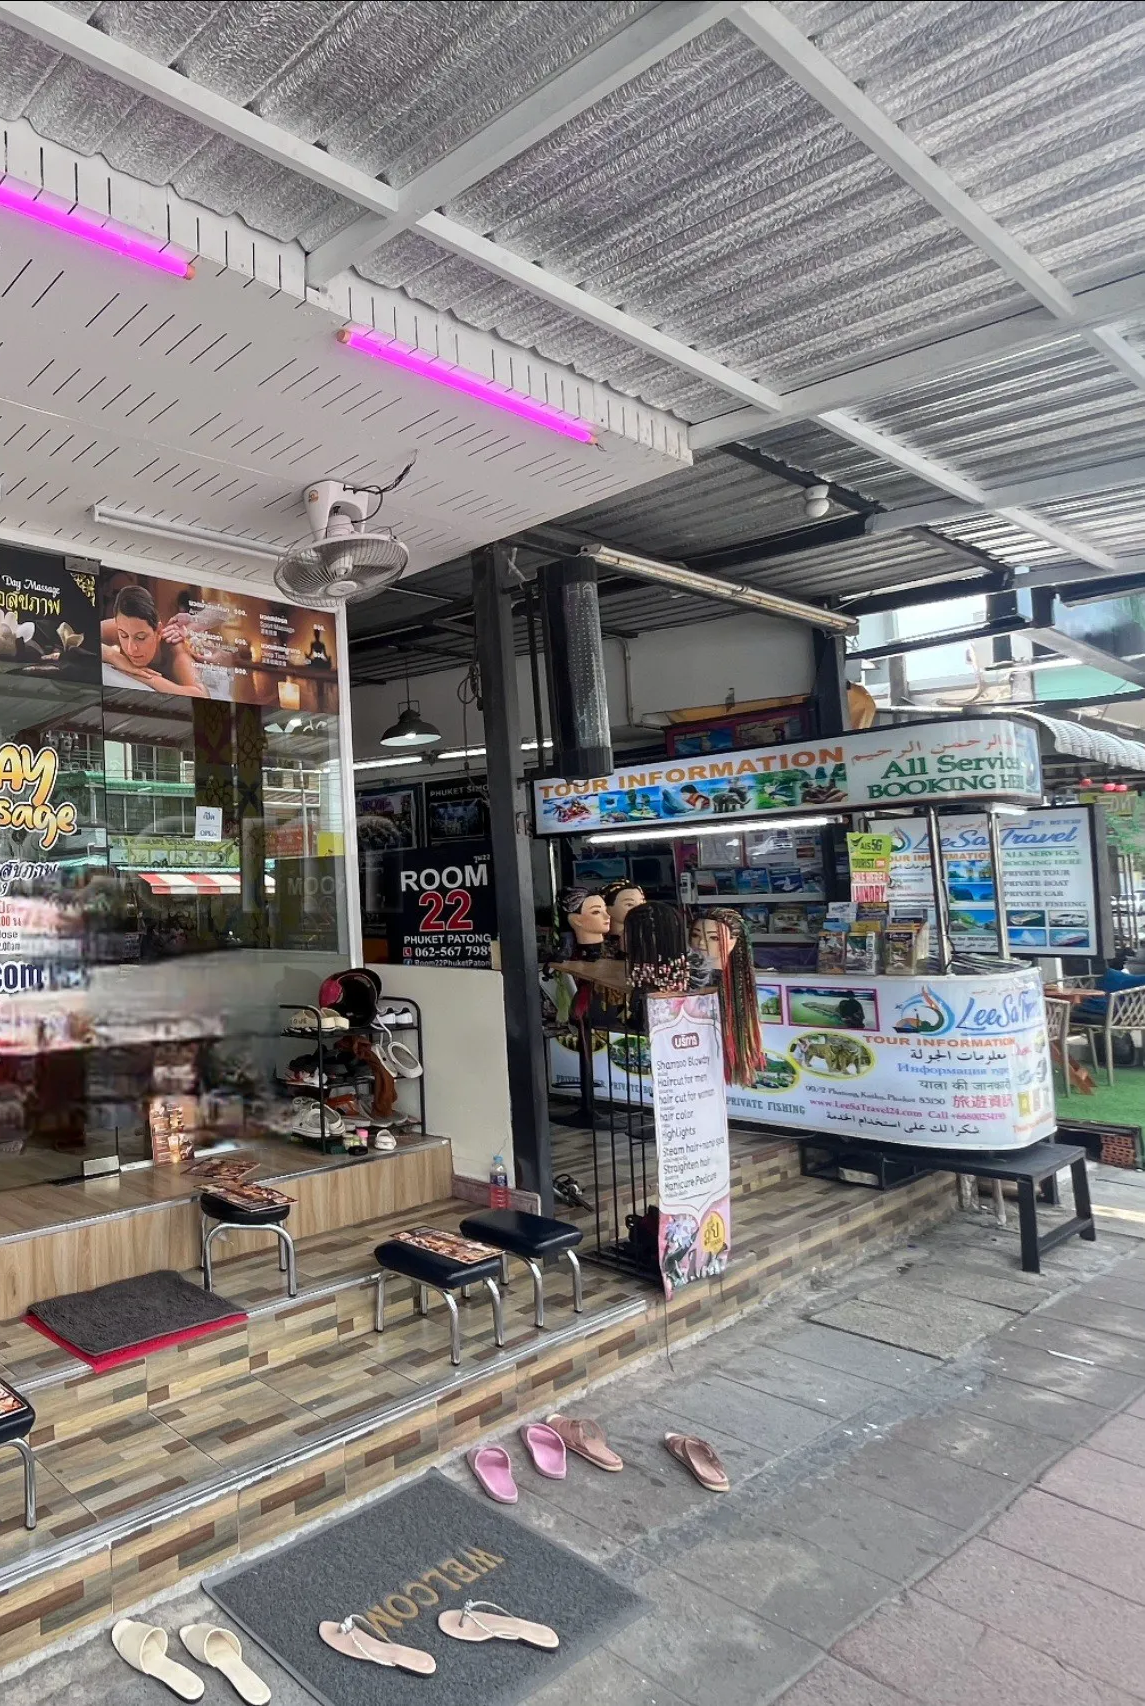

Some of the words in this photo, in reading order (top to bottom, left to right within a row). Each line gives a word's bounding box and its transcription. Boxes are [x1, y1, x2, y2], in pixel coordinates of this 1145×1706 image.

[2, 574, 22, 591] Day
[23, 578, 61, 599] Massage
[538, 777, 610, 800] TOUR
[618, 745, 845, 791] INFORMATION
[881, 756, 929, 780] All
[429, 786, 465, 798] PHUKET
[867, 773, 998, 799] BOOKING
[999, 826, 1078, 846] Travel
[871, 838, 883, 851] 5G
[400, 863, 489, 893] ROOM
[1002, 869, 1042, 877] PRIVATE
[1043, 869, 1071, 877] TOUR
[1044, 879, 1069, 887] BOAT
[418, 888, 474, 933] 22
[404, 934, 445, 945] PHUKET
[447, 933, 492, 945] PATONG
[414, 945, 462, 958] 062-567
[863, 1034, 911, 1047] TOUR
[916, 1036, 1017, 1049] INFORMATION
[674, 1093, 687, 1104] cut
[725, 1096, 764, 1110] PRIVATE
[767, 1101, 806, 1116] FISHING
[675, 1109, 694, 1120] color
[928, 1110, 949, 1120] Call
